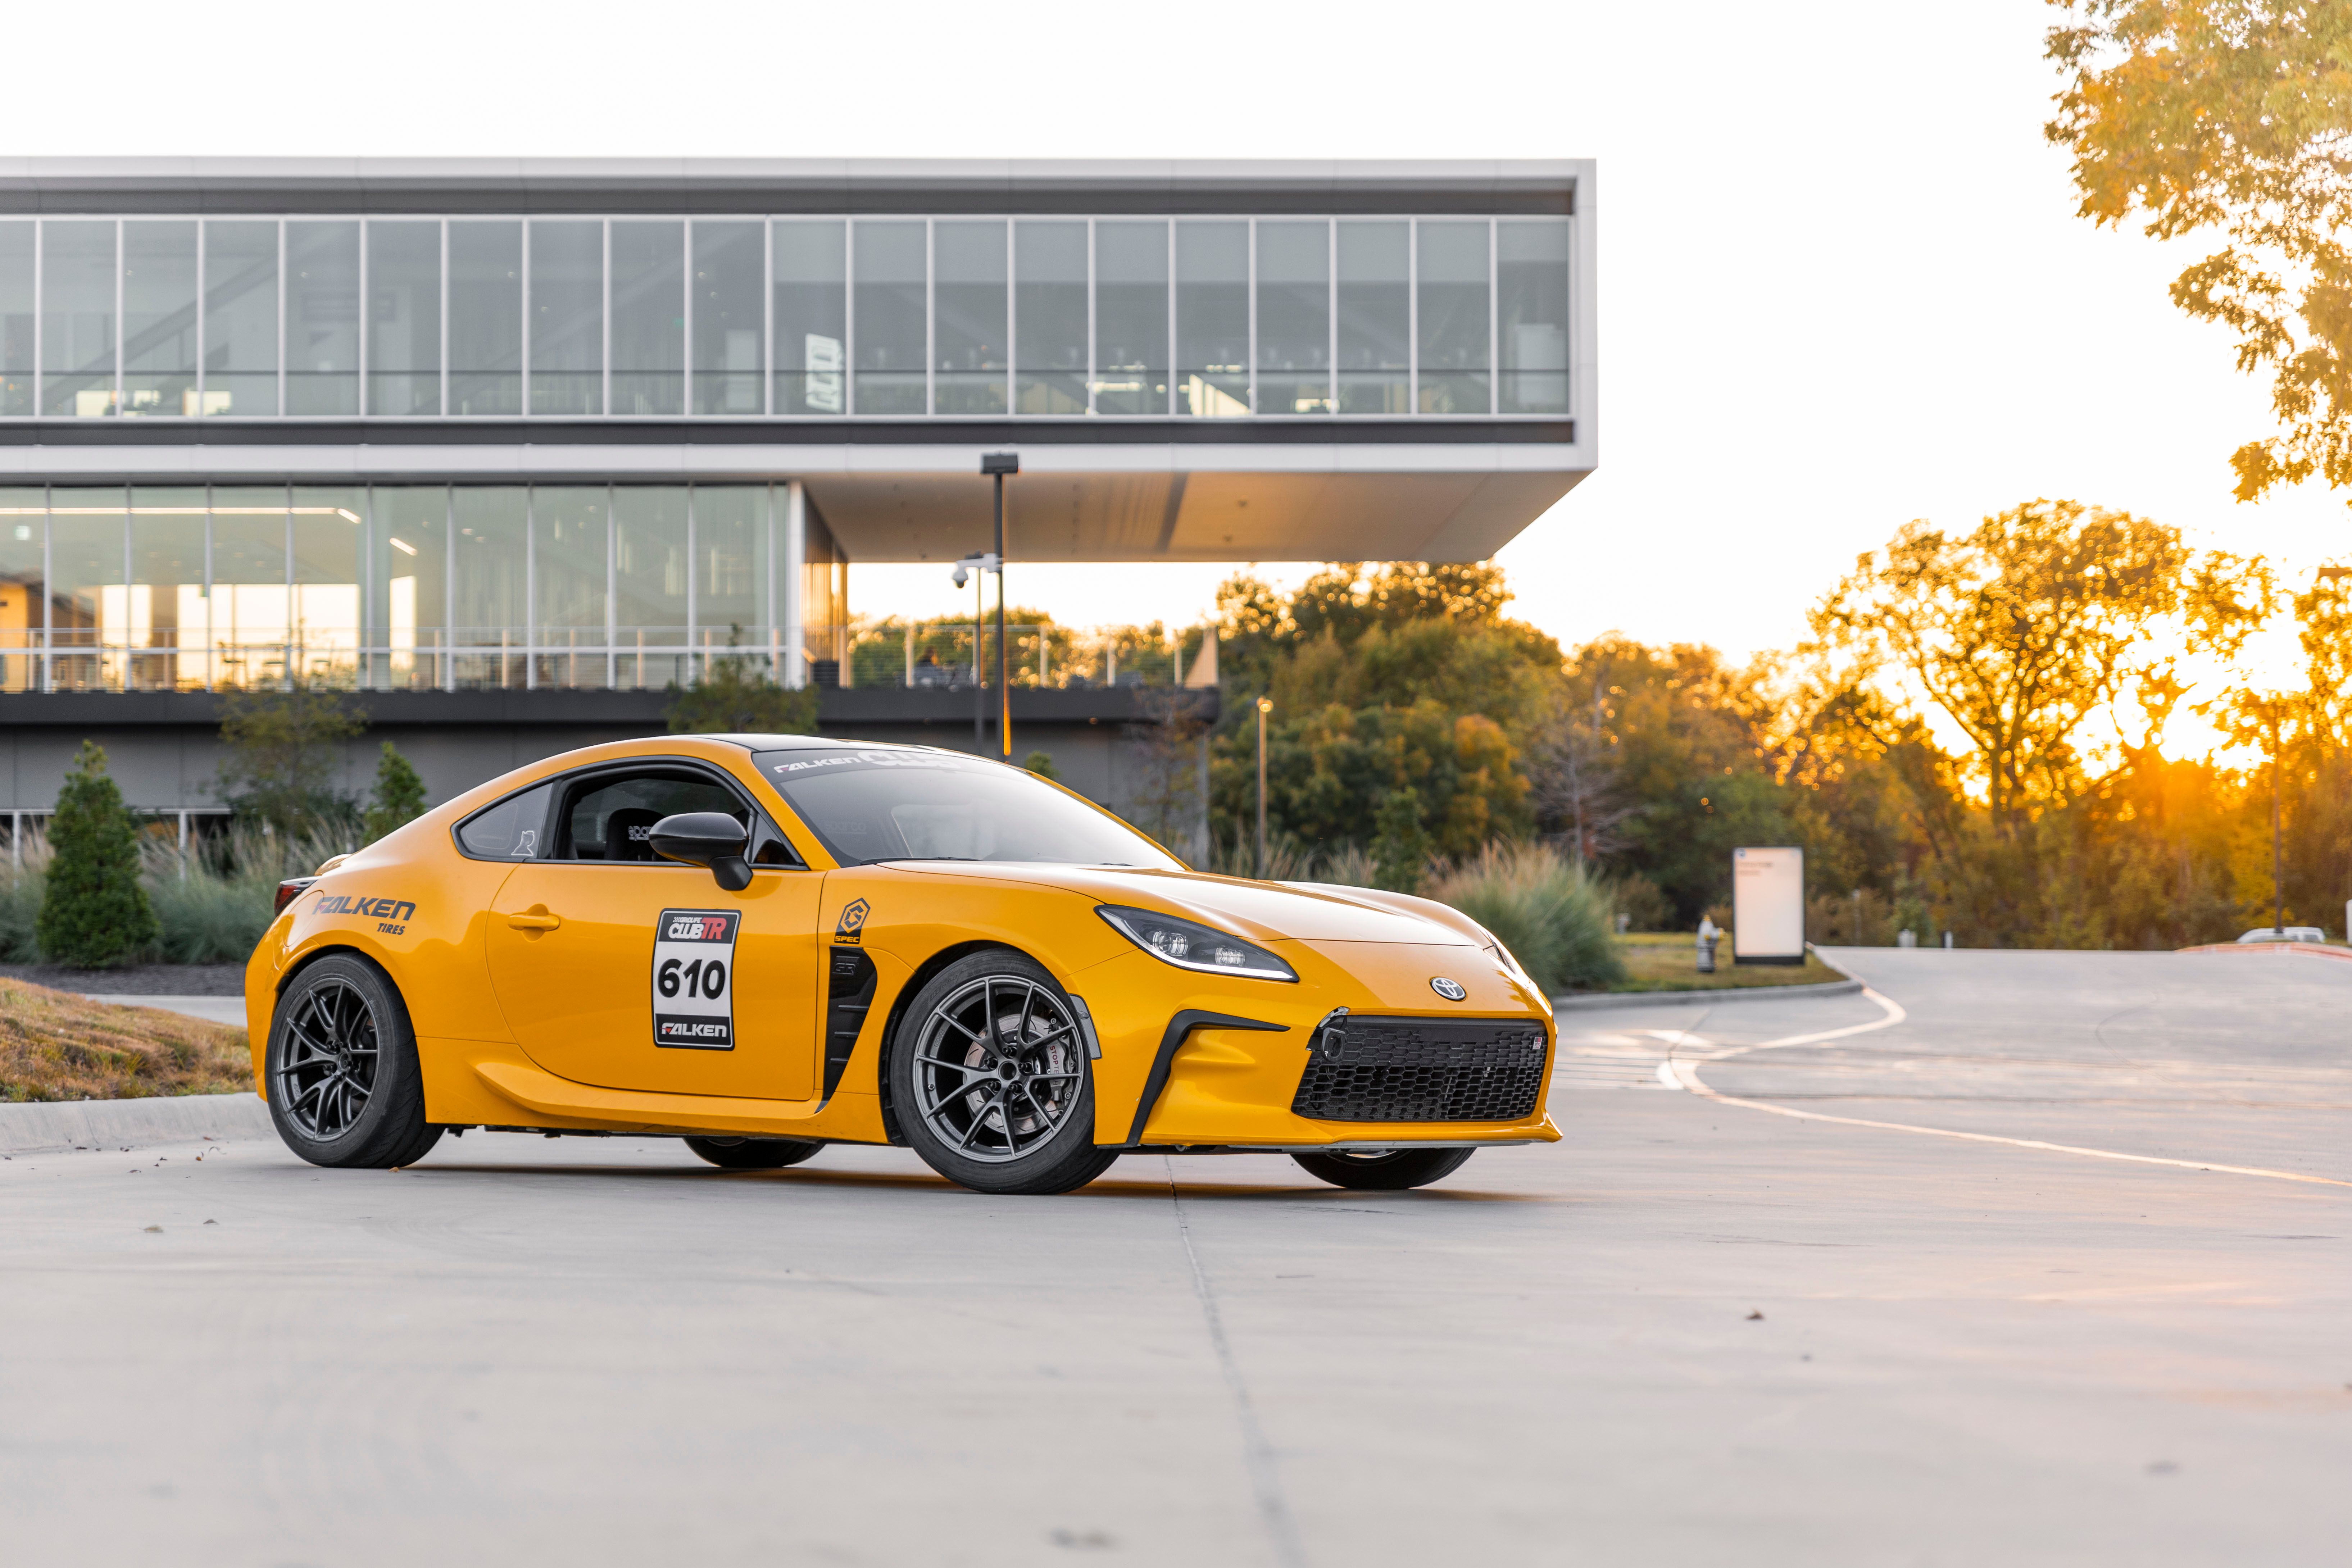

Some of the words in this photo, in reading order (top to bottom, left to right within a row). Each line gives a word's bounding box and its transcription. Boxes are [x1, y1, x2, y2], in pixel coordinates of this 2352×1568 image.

[773, 757, 860, 773] FALKEN
[312, 896, 416, 921] FALKEN
[377, 923, 405, 935] TIRES
[657, 958, 725, 1000] 610
[660, 1022, 727, 1037] FALKEN
[1050, 1045, 1059, 1085] STOPTEH
